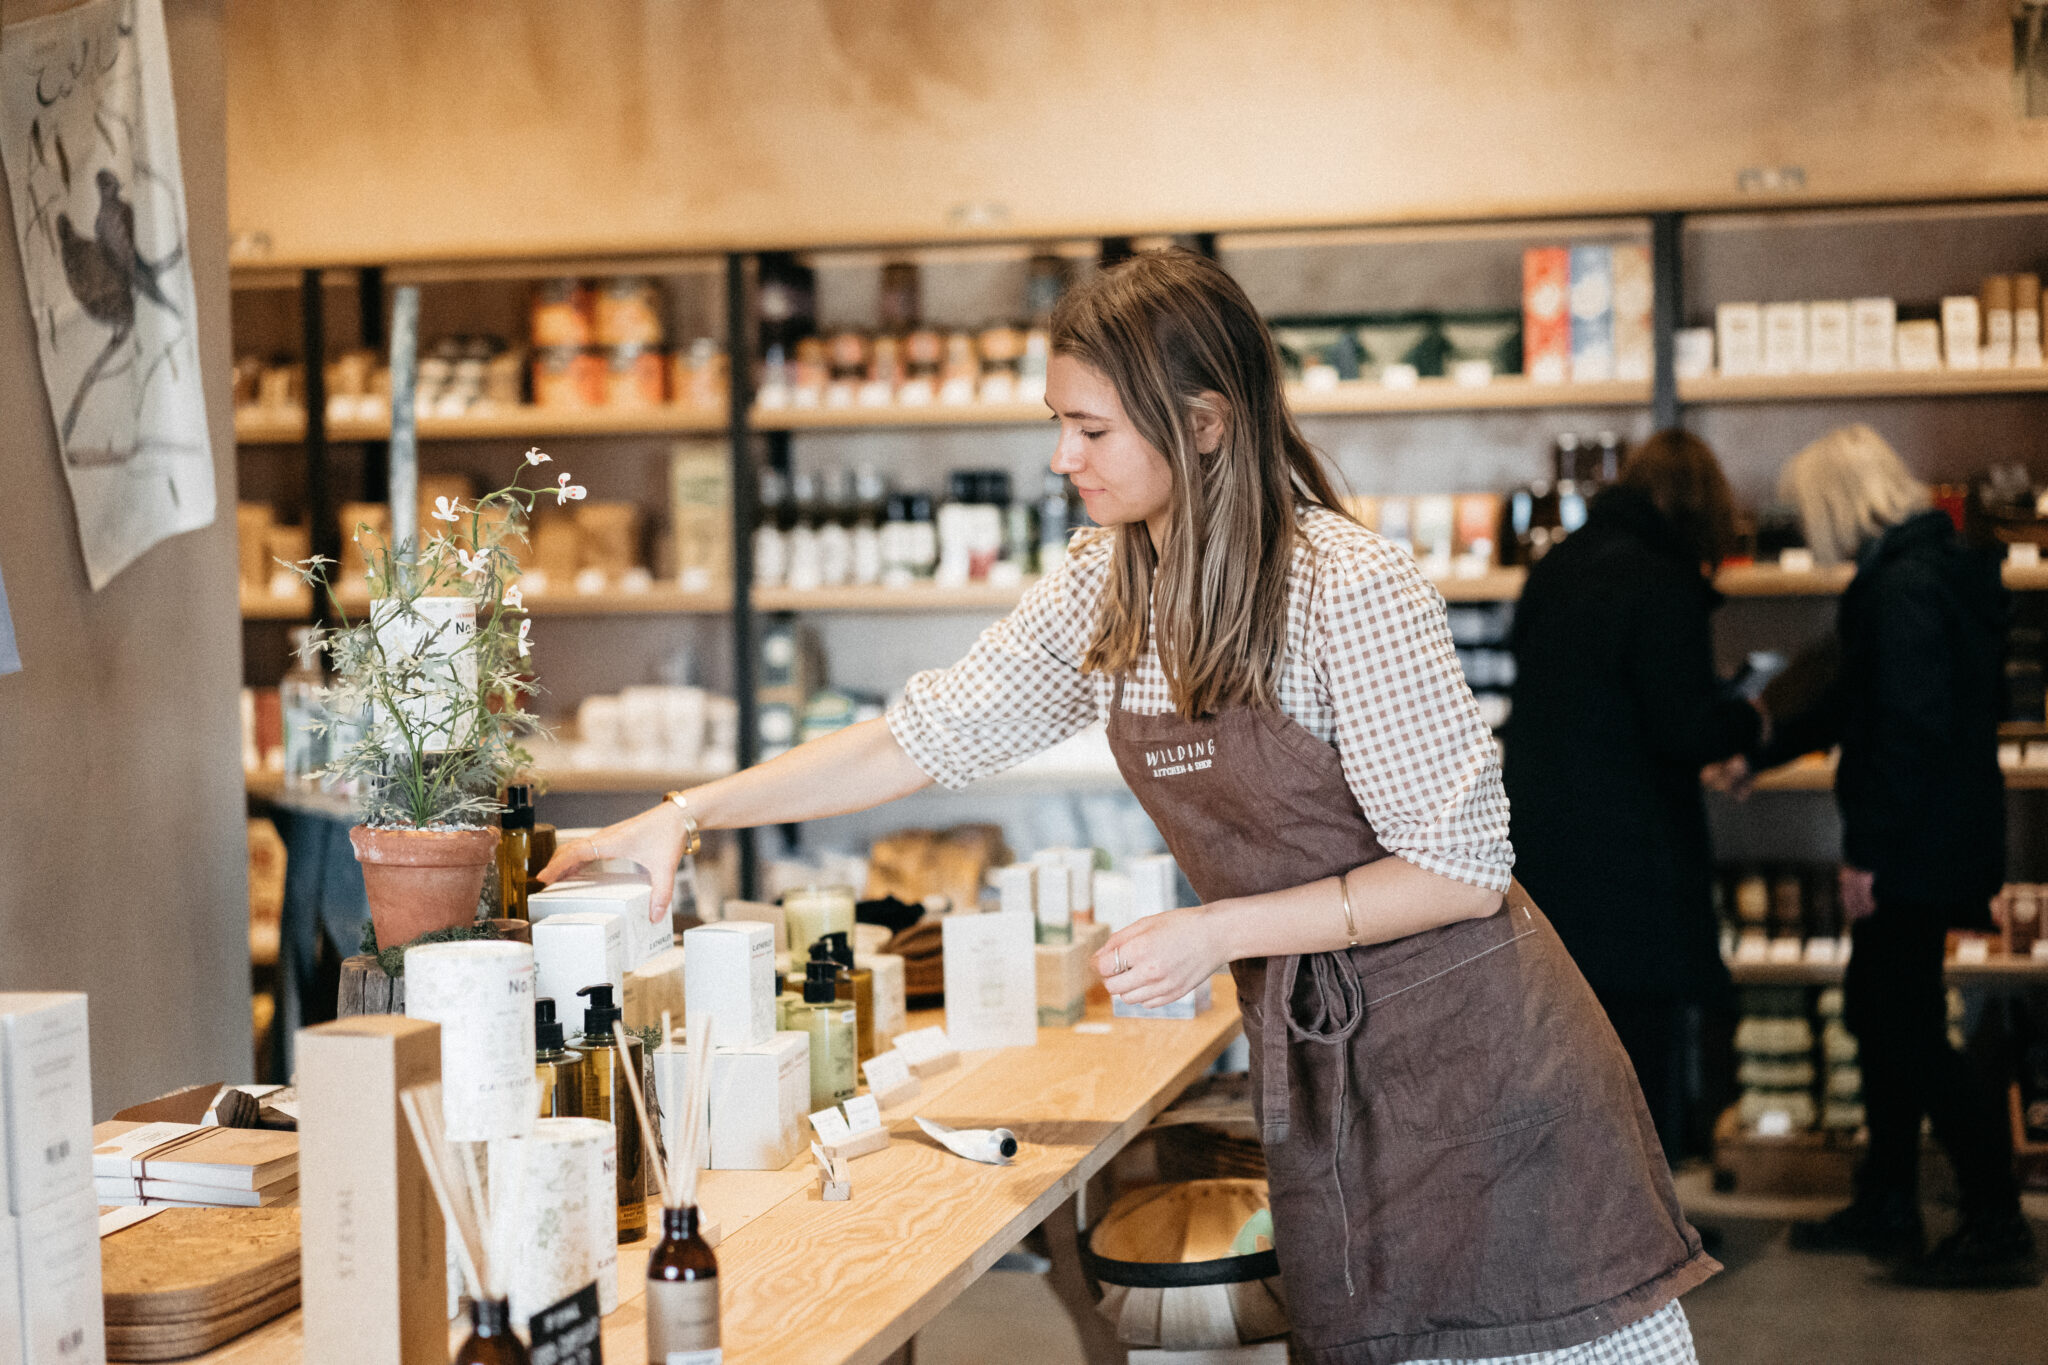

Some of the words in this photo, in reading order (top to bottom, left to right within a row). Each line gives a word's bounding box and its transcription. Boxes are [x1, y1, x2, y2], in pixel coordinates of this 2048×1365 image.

[1145, 739, 1215, 767] WILDING
[1187, 763, 1194, 772] &
[1194, 759, 1212, 771] SHOP
